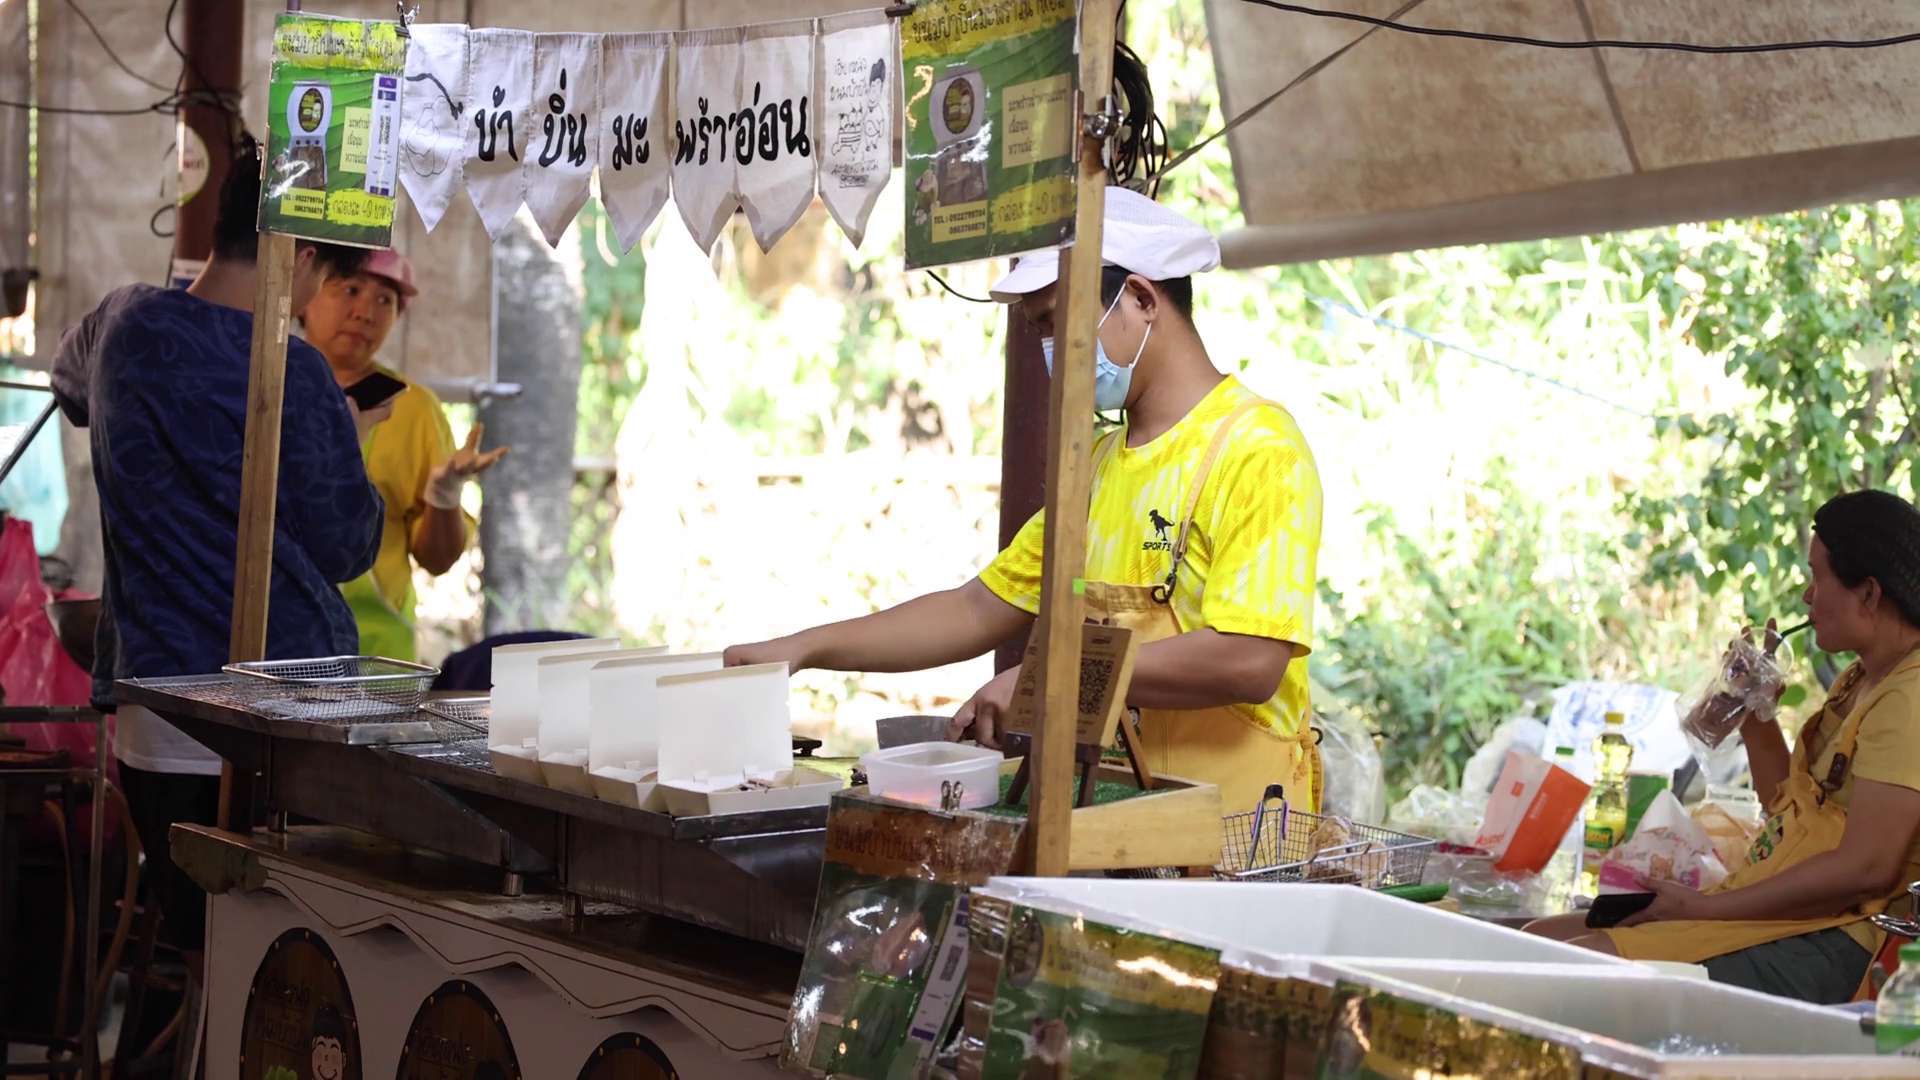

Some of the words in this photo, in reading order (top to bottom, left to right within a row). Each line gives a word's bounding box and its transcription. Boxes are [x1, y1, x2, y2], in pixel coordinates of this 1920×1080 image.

[474, 85, 518, 162] บ้า
[538, 67, 587, 167] บิ่น
[612, 113, 650, 171] มะ
[362, 199, 373, 218] 40
[1036, 192, 1049, 215] 40
[934, 215, 945, 225] TEL
